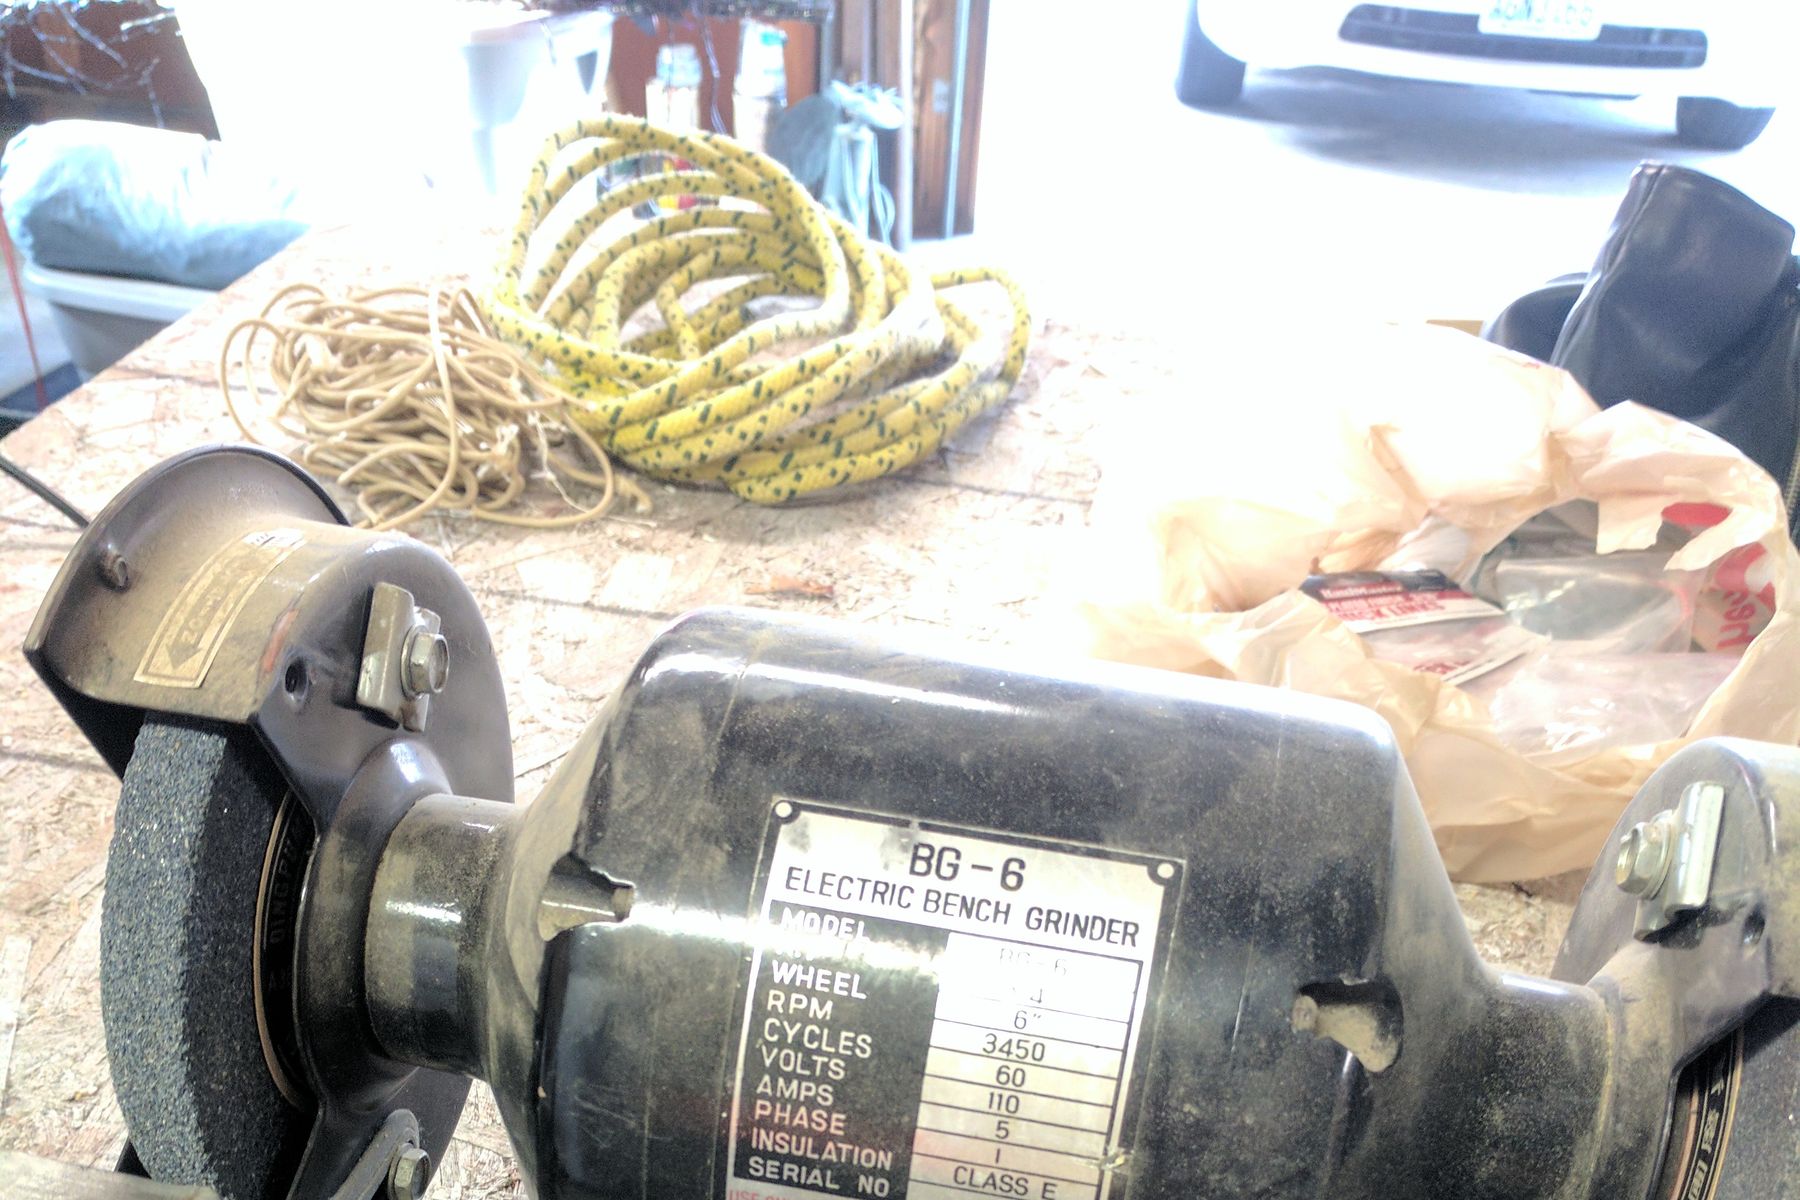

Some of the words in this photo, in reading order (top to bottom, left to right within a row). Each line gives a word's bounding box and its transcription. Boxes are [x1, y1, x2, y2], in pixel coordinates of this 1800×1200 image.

[910, 842, 1027, 892] BG-6
[785, 866, 912, 909] ELECTRIC
[923, 887, 1010, 926] BENCH
[1025, 907, 1140, 947] GRINDER
[780, 907, 870, 942] MODEL
[771, 959, 867, 1000] WHEEL
[767, 989, 833, 1020] RPM
[764, 1017, 873, 1059] CYCLES
[982, 1034, 1046, 1062] 3450
[759, 1045, 846, 1081] VOLTS
[995, 1065, 1026, 1088] 60
[756, 1074, 834, 1107] AMPS
[987, 1091, 1020, 1115] 110
[754, 1101, 846, 1137] PHASE
[995, 1121, 1010, 1140] 5
[751, 1127, 893, 1171] INSULATION
[748, 1157, 840, 1191] SERIAL
[858, 1174, 890, 1198] NO
[953, 1165, 1029, 1196] CLASS
